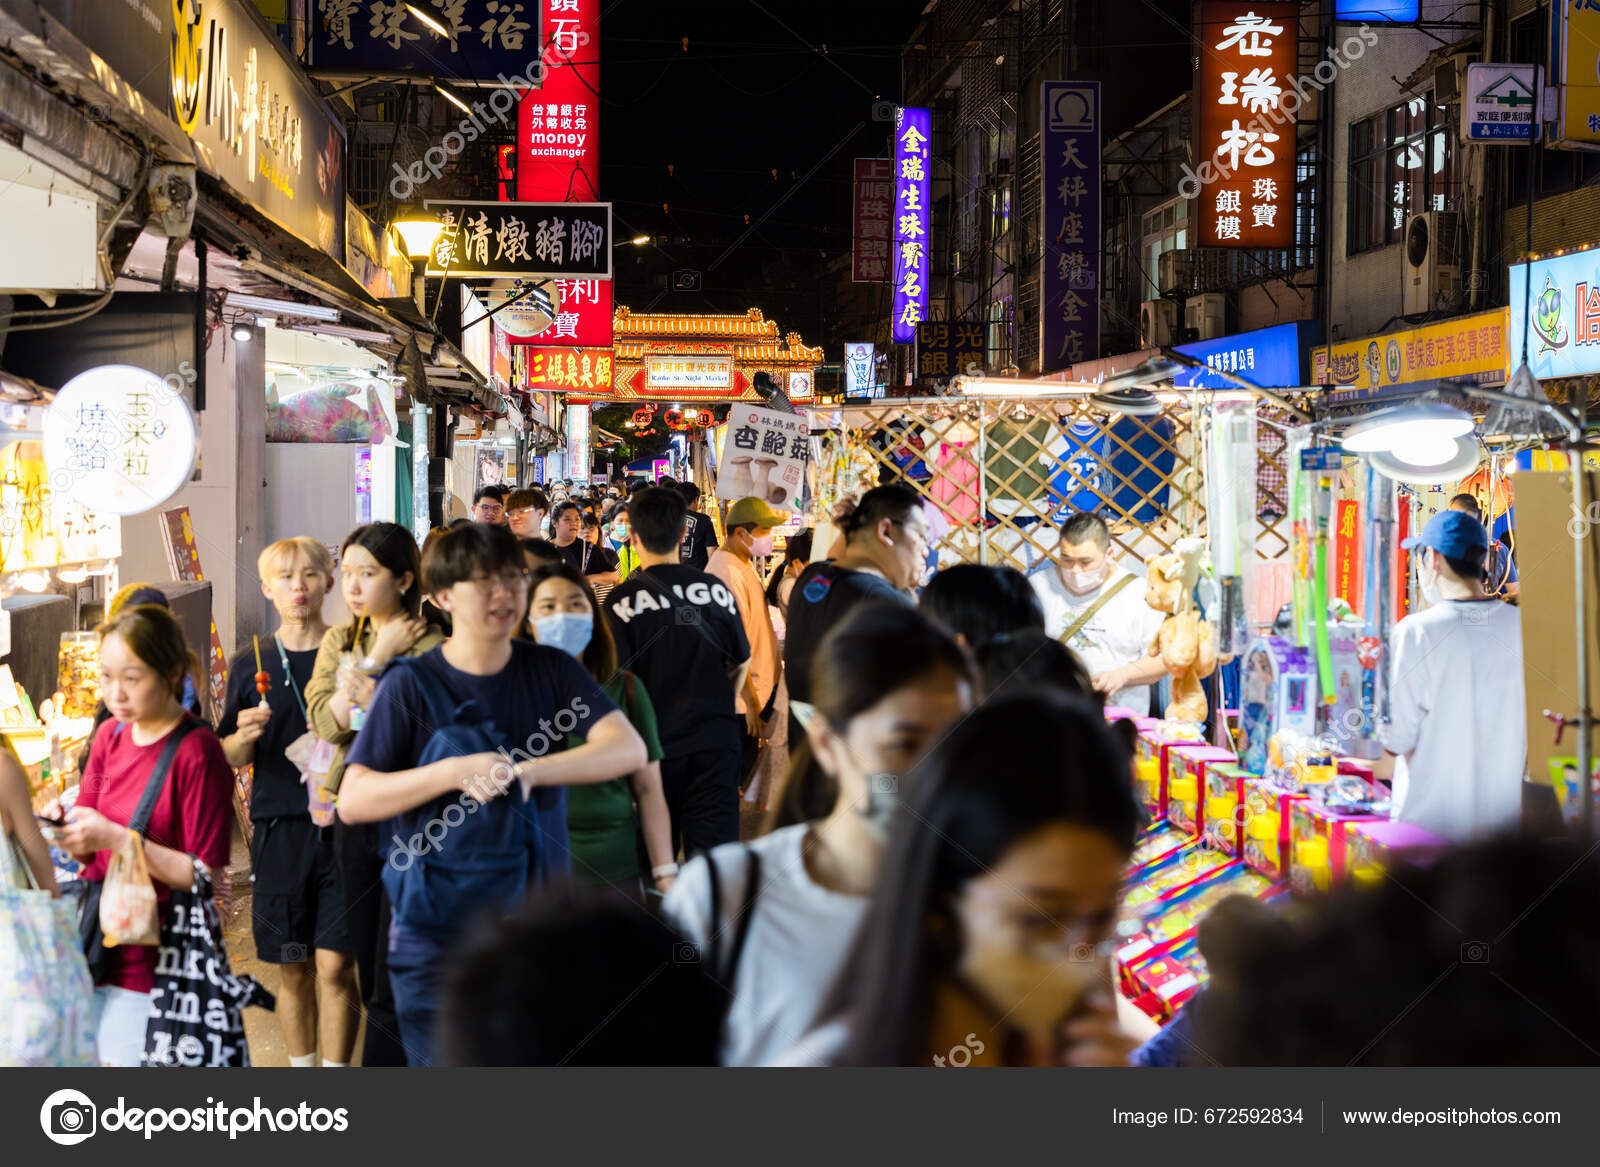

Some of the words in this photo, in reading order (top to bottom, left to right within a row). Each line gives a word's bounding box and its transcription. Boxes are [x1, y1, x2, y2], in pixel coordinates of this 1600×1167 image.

[532, 104, 586, 116] 台灣銀行
[531, 132, 586, 148] money
[531, 147, 586, 158] exchanger
[1215, 190, 1242, 240] 銀樓
[1251, 178, 1278, 228] 珠寶
[463, 211, 604, 268] 清燉豬腳
[899, 126, 927, 327] 金瑞生珠寶名店
[531, 353, 612, 388] 三媽臭臭鍋
